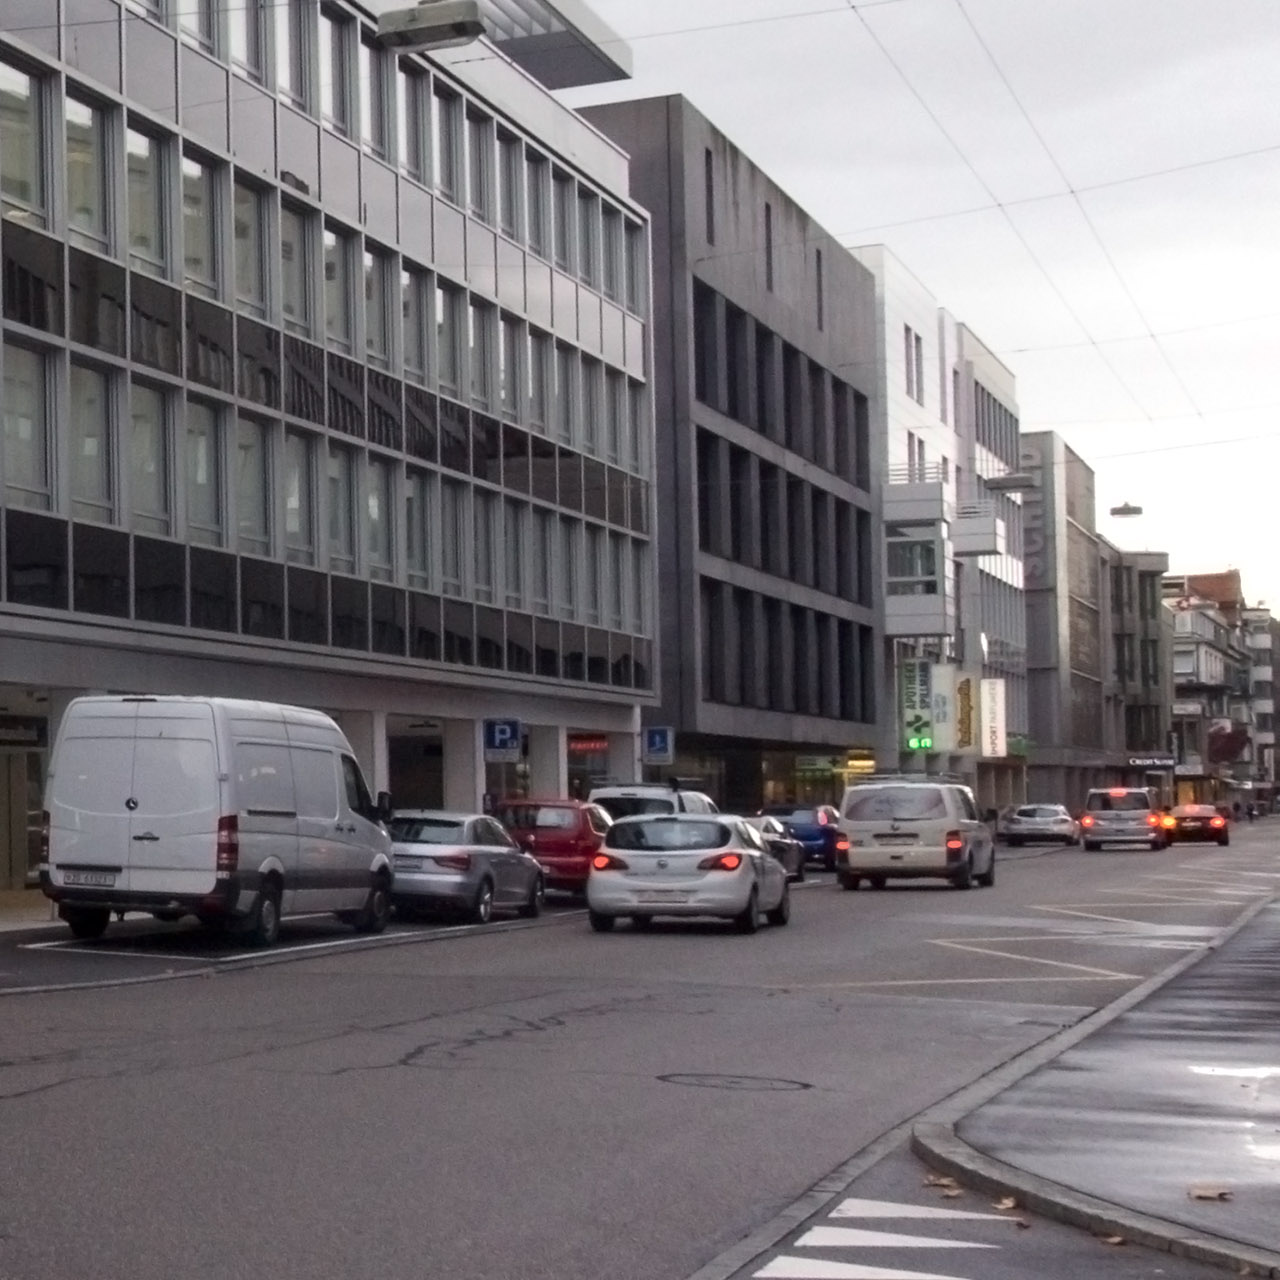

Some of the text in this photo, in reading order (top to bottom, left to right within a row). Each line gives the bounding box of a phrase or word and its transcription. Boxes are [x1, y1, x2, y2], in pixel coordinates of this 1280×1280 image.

[905, 661, 917, 710] APOTHEKE
[494, 724, 511, 747] P
[990, 725, 999, 756] IMPORT
